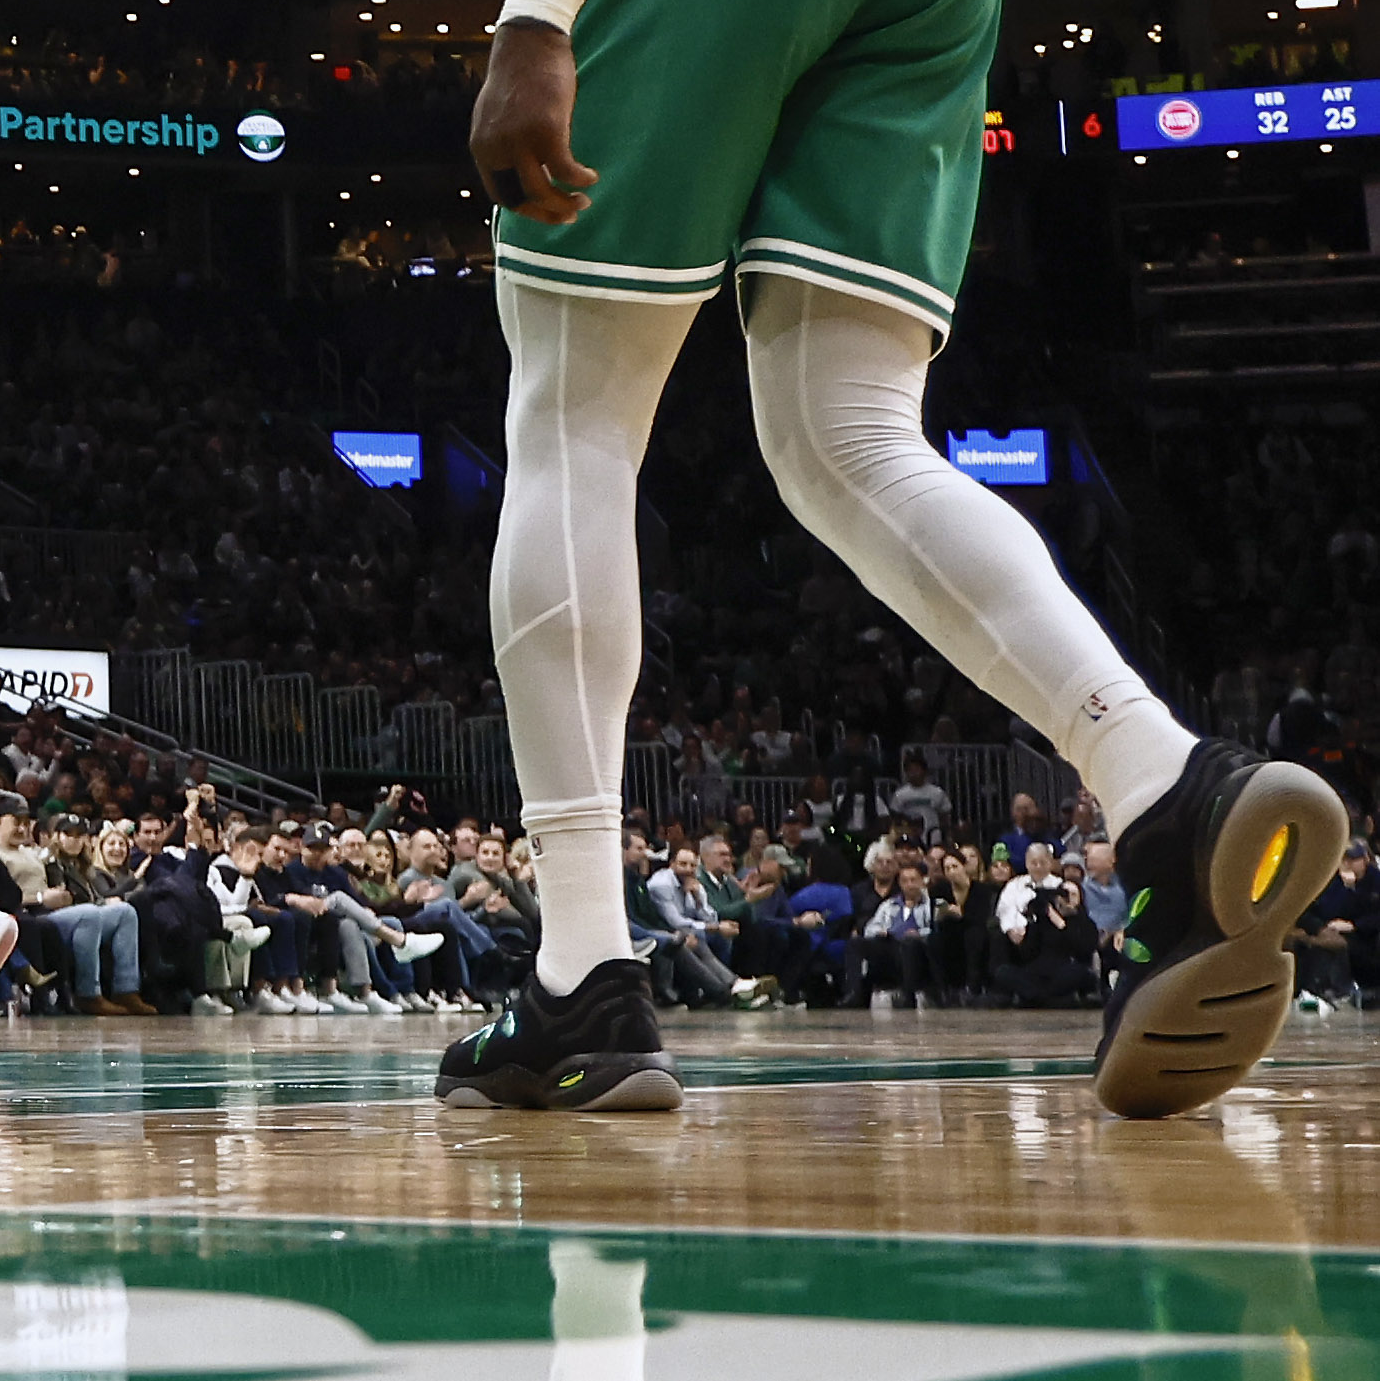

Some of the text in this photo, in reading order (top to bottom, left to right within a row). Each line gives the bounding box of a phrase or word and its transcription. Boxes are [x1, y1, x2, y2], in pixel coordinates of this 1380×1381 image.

[1322, 86, 1353, 103] AST
[0, 106, 220, 156] Partnership
[1257, 106, 1357, 135] 32 25
